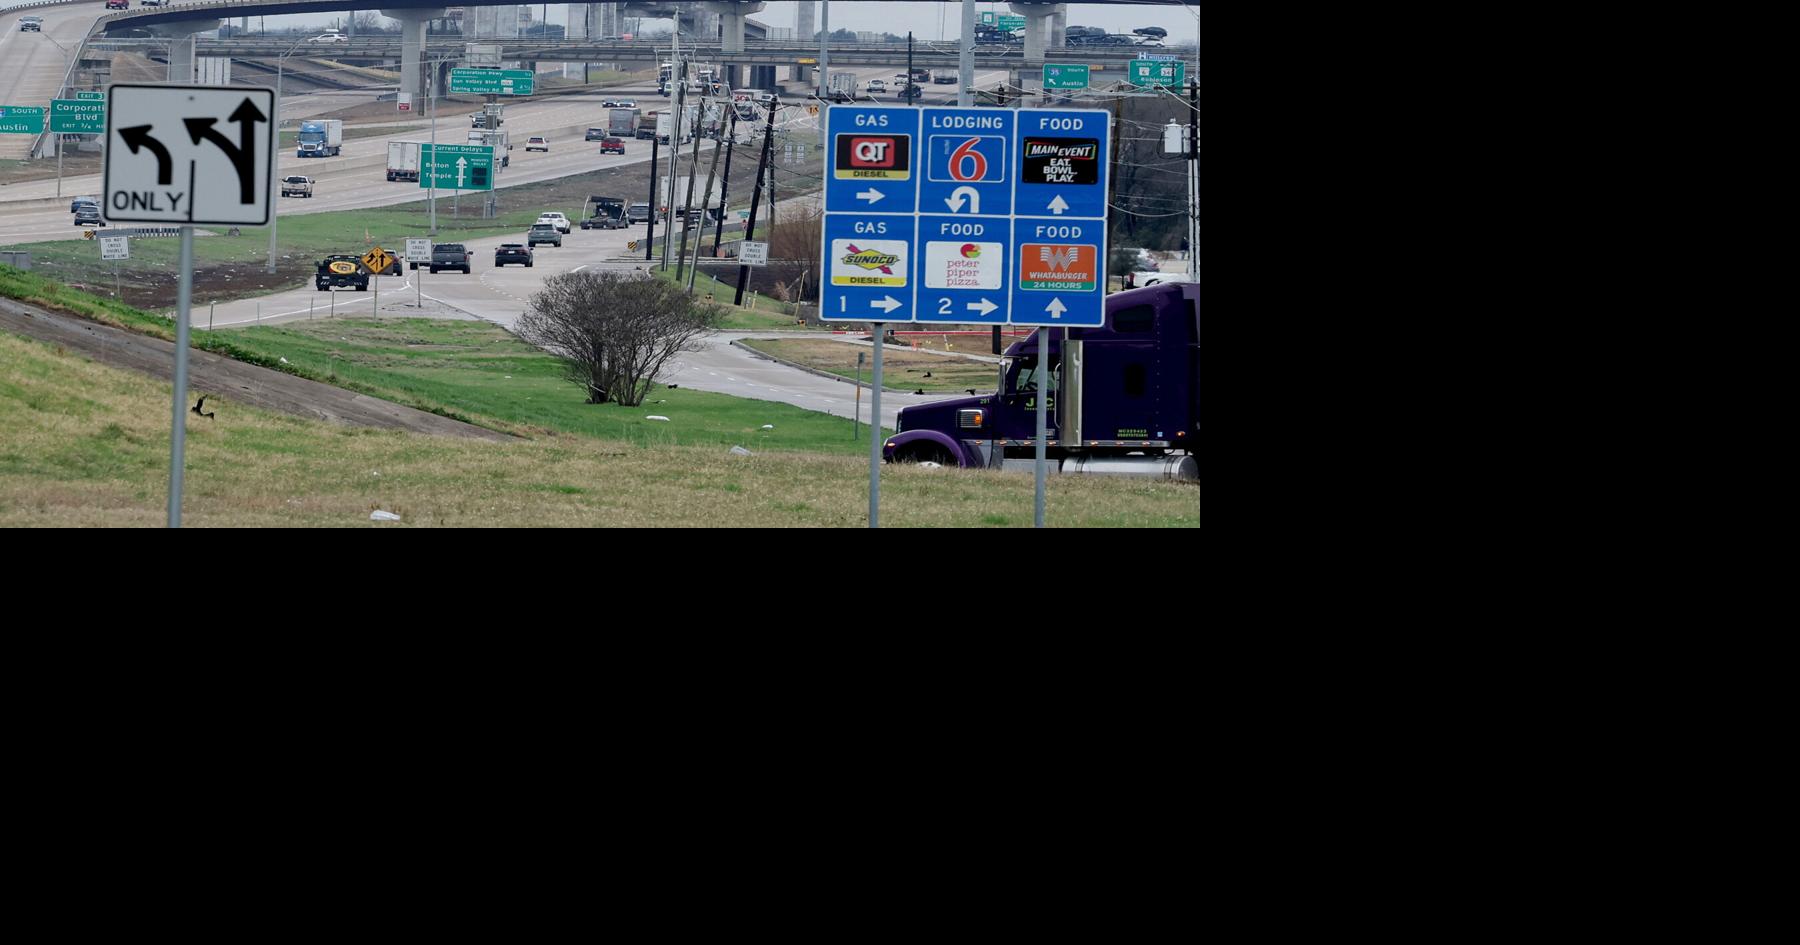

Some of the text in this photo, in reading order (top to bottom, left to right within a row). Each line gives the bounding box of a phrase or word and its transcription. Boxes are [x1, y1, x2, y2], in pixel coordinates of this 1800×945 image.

[855, 114, 888, 127] GAS
[932, 116, 1003, 129] LODGING
[1040, 118, 1083, 130] FOOD
[855, 141, 888, 162] QT
[1031, 145, 1091, 156] MAIN EVENT
[948, 136, 988, 182] 6
[1043, 166, 1078, 174] BOWL.
[1046, 174, 1074, 182] PLAY.
[113, 191, 183, 212] ONLY
[855, 222, 887, 234] GAS
[941, 223, 984, 236] FOOD
[1036, 226, 1082, 238] FOOD
[846, 255, 895, 264] SUNOCO
[947, 260, 979, 268] peter
[946, 268, 979, 277] piper
[840, 296, 846, 312] 1
[938, 298, 952, 314] 2
